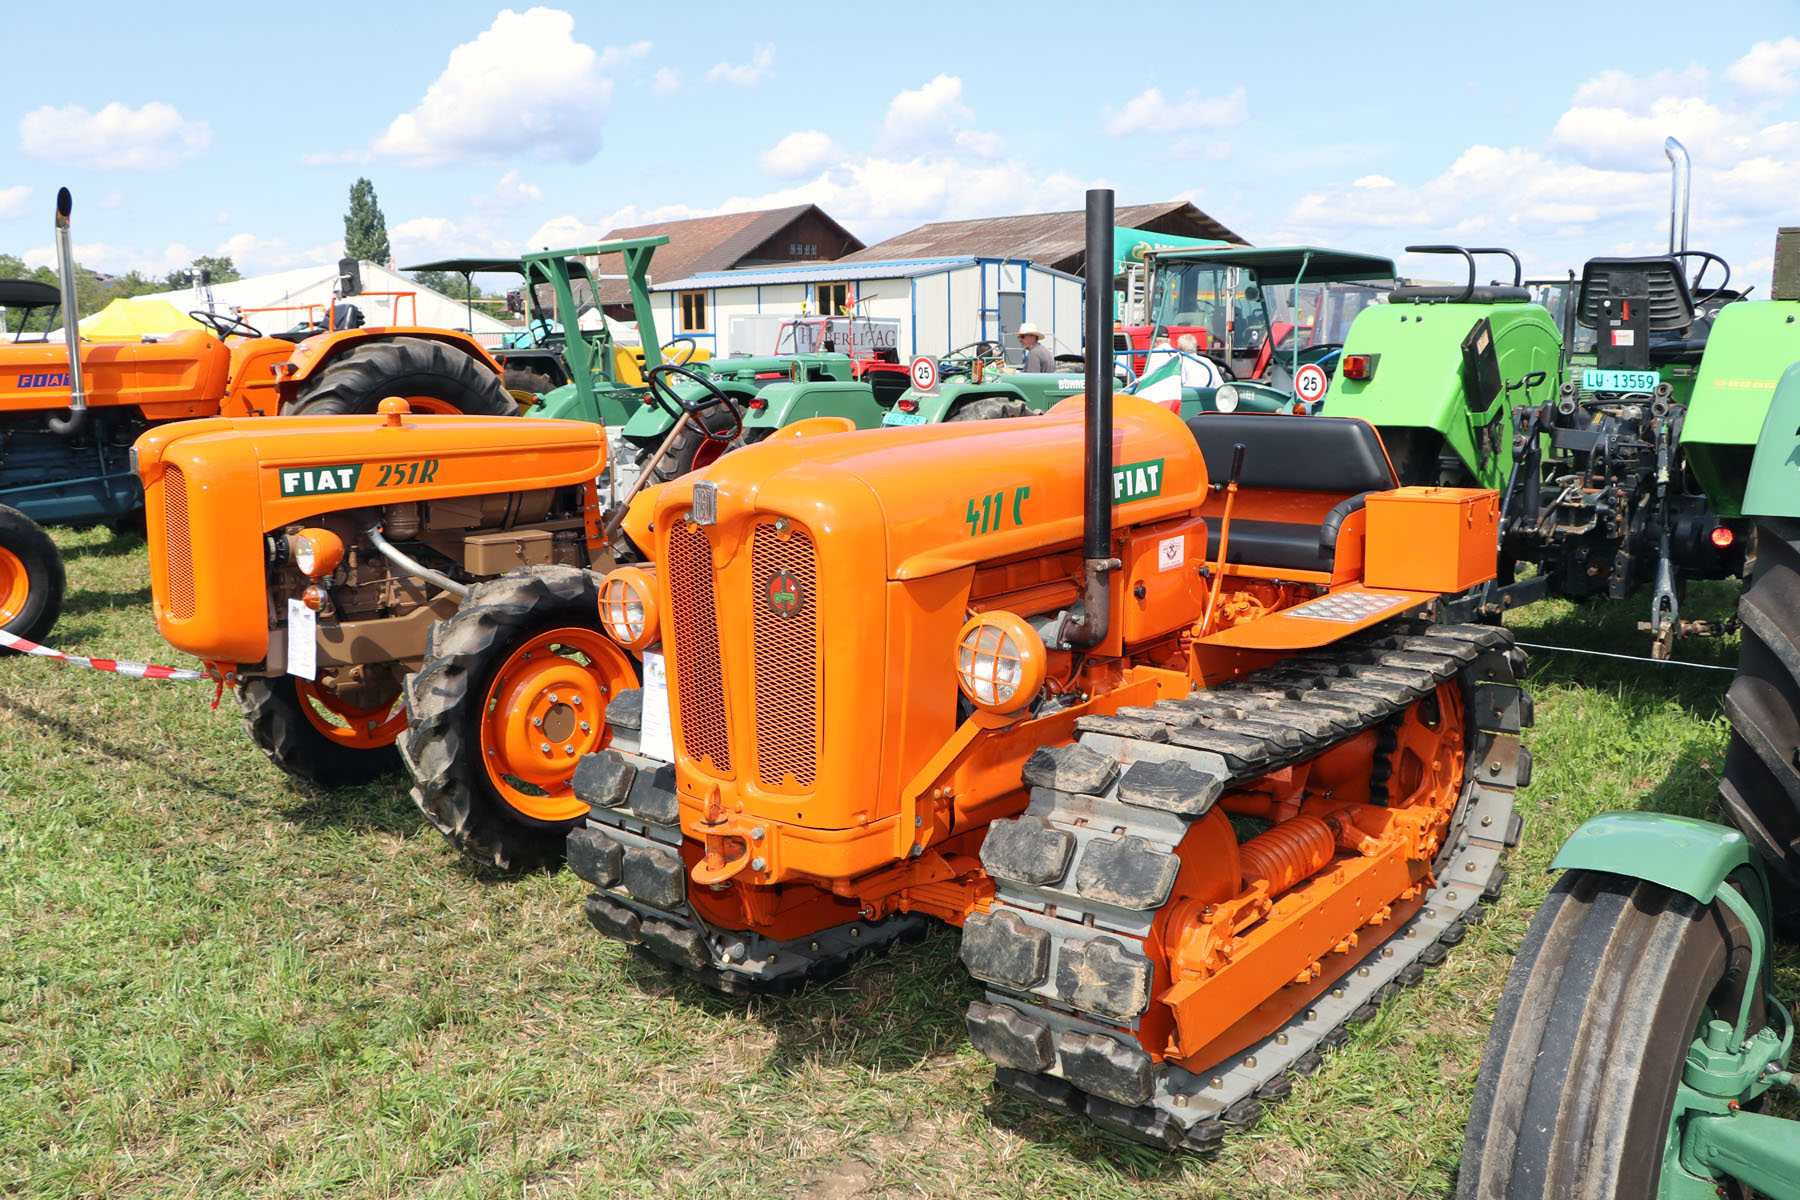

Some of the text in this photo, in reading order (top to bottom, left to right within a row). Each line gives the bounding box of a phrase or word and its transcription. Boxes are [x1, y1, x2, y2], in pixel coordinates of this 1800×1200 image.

[801, 326, 896, 347] HBERLI AG
[918, 366, 930, 380] 25
[1613, 374, 1655, 389] 13559
[1058, 378, 1086, 390] BÜHRE
[1303, 376, 1318, 391] 25
[283, 459, 439, 493] FIAT 251R
[1113, 464, 1159, 499] FIAT
[965, 486, 1031, 537] 411 C
